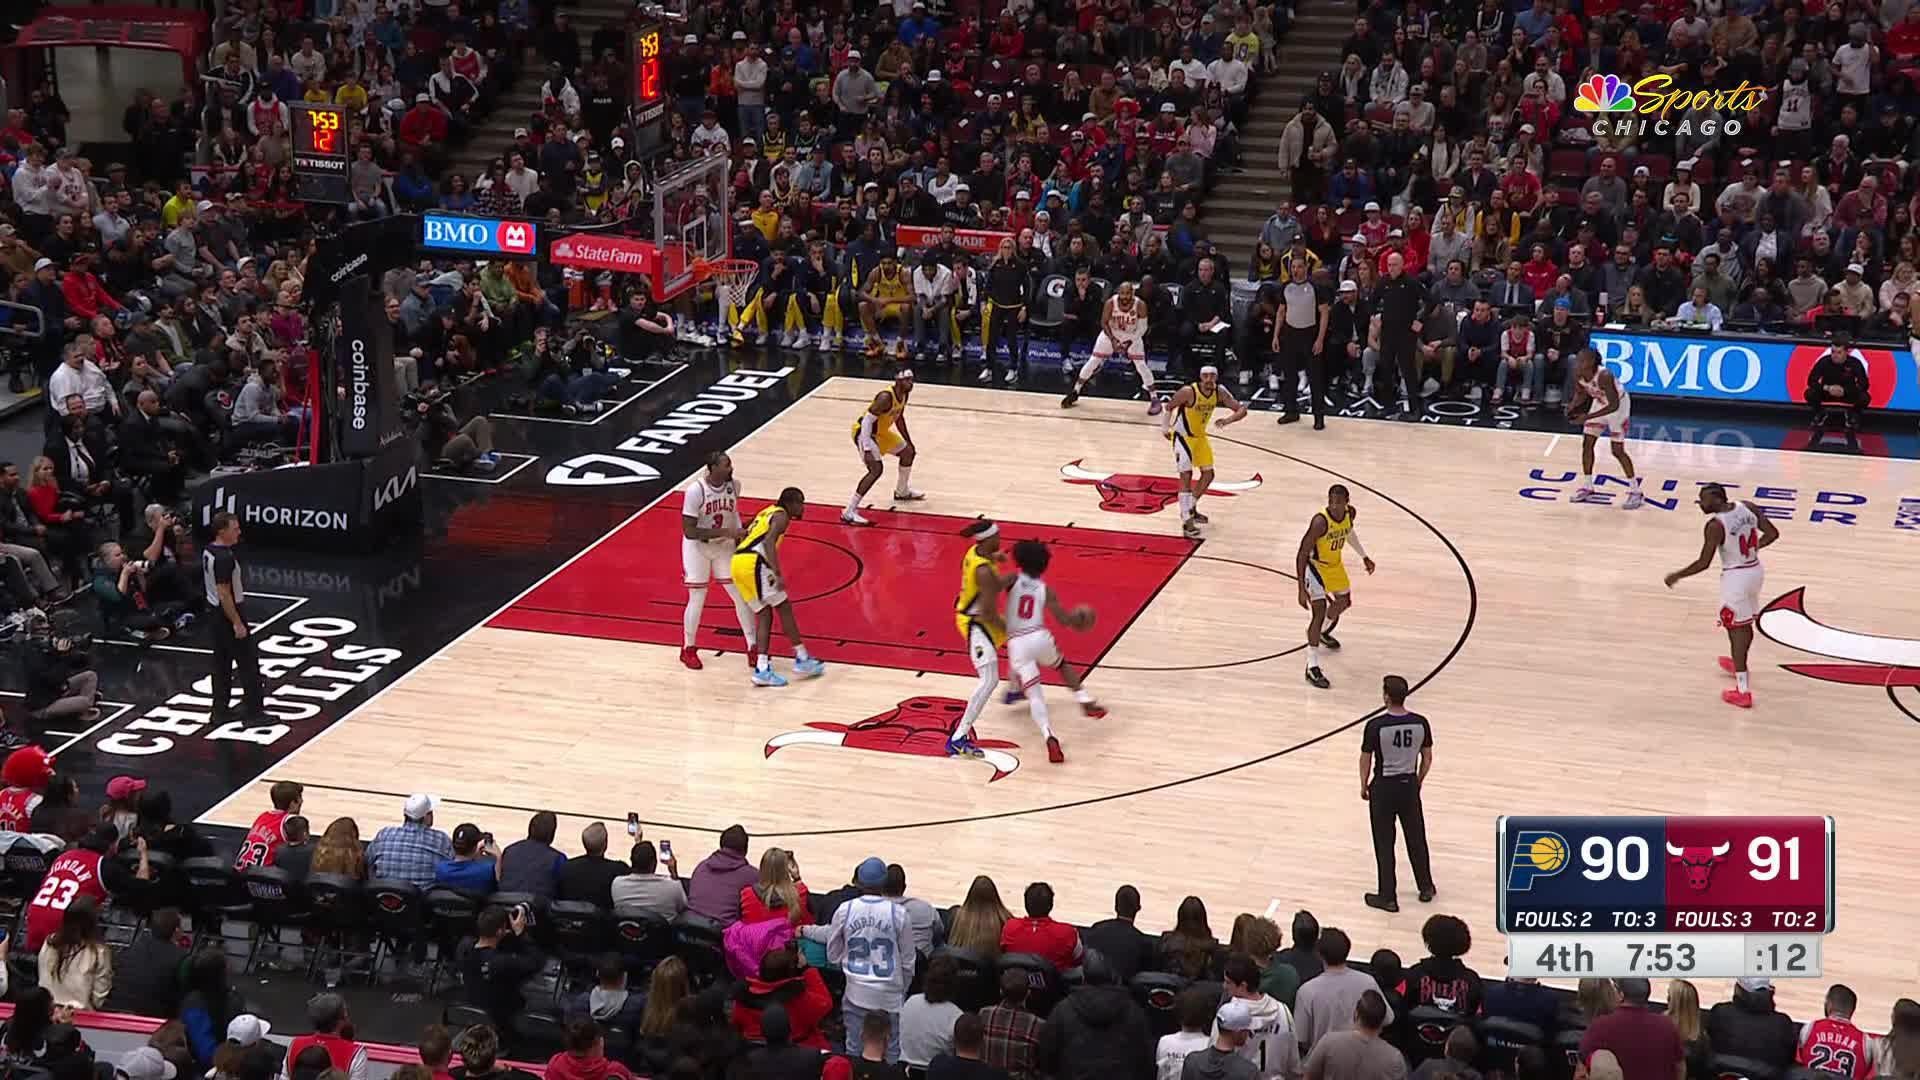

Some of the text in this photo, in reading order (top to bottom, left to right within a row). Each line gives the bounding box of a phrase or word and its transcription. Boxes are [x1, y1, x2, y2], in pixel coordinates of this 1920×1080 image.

[640, 32, 658, 57] 7:53
[643, 58, 657, 96] 12
[308, 111, 338, 129] 7:53
[313, 130, 331, 151] 12
[309, 160, 344, 169] TISSOT
[424, 220, 488, 244] BMO
[922, 233, 986, 247] GARADE
[331, 253, 368, 282] coinbase
[1590, 337, 1762, 393] BMO
[351, 339, 370, 430] coinbase
[615, 366, 796, 455] FANDUEL
[245, 504, 348, 530] HORIZON
[1519, 487, 1858, 526] CENER
[1331, 537, 1345, 551] 00
[1017, 594, 1034, 620] 0
[204, 644, 403, 746] BULLS
[1393, 729, 1413, 748] 46
[32, 876, 79, 910] 23
[848, 915, 892, 934] JORDAN
[847, 937, 896, 978] 23
[1816, 1031, 1857, 1049] JORDAN
[1808, 1043, 1857, 1080] 23
